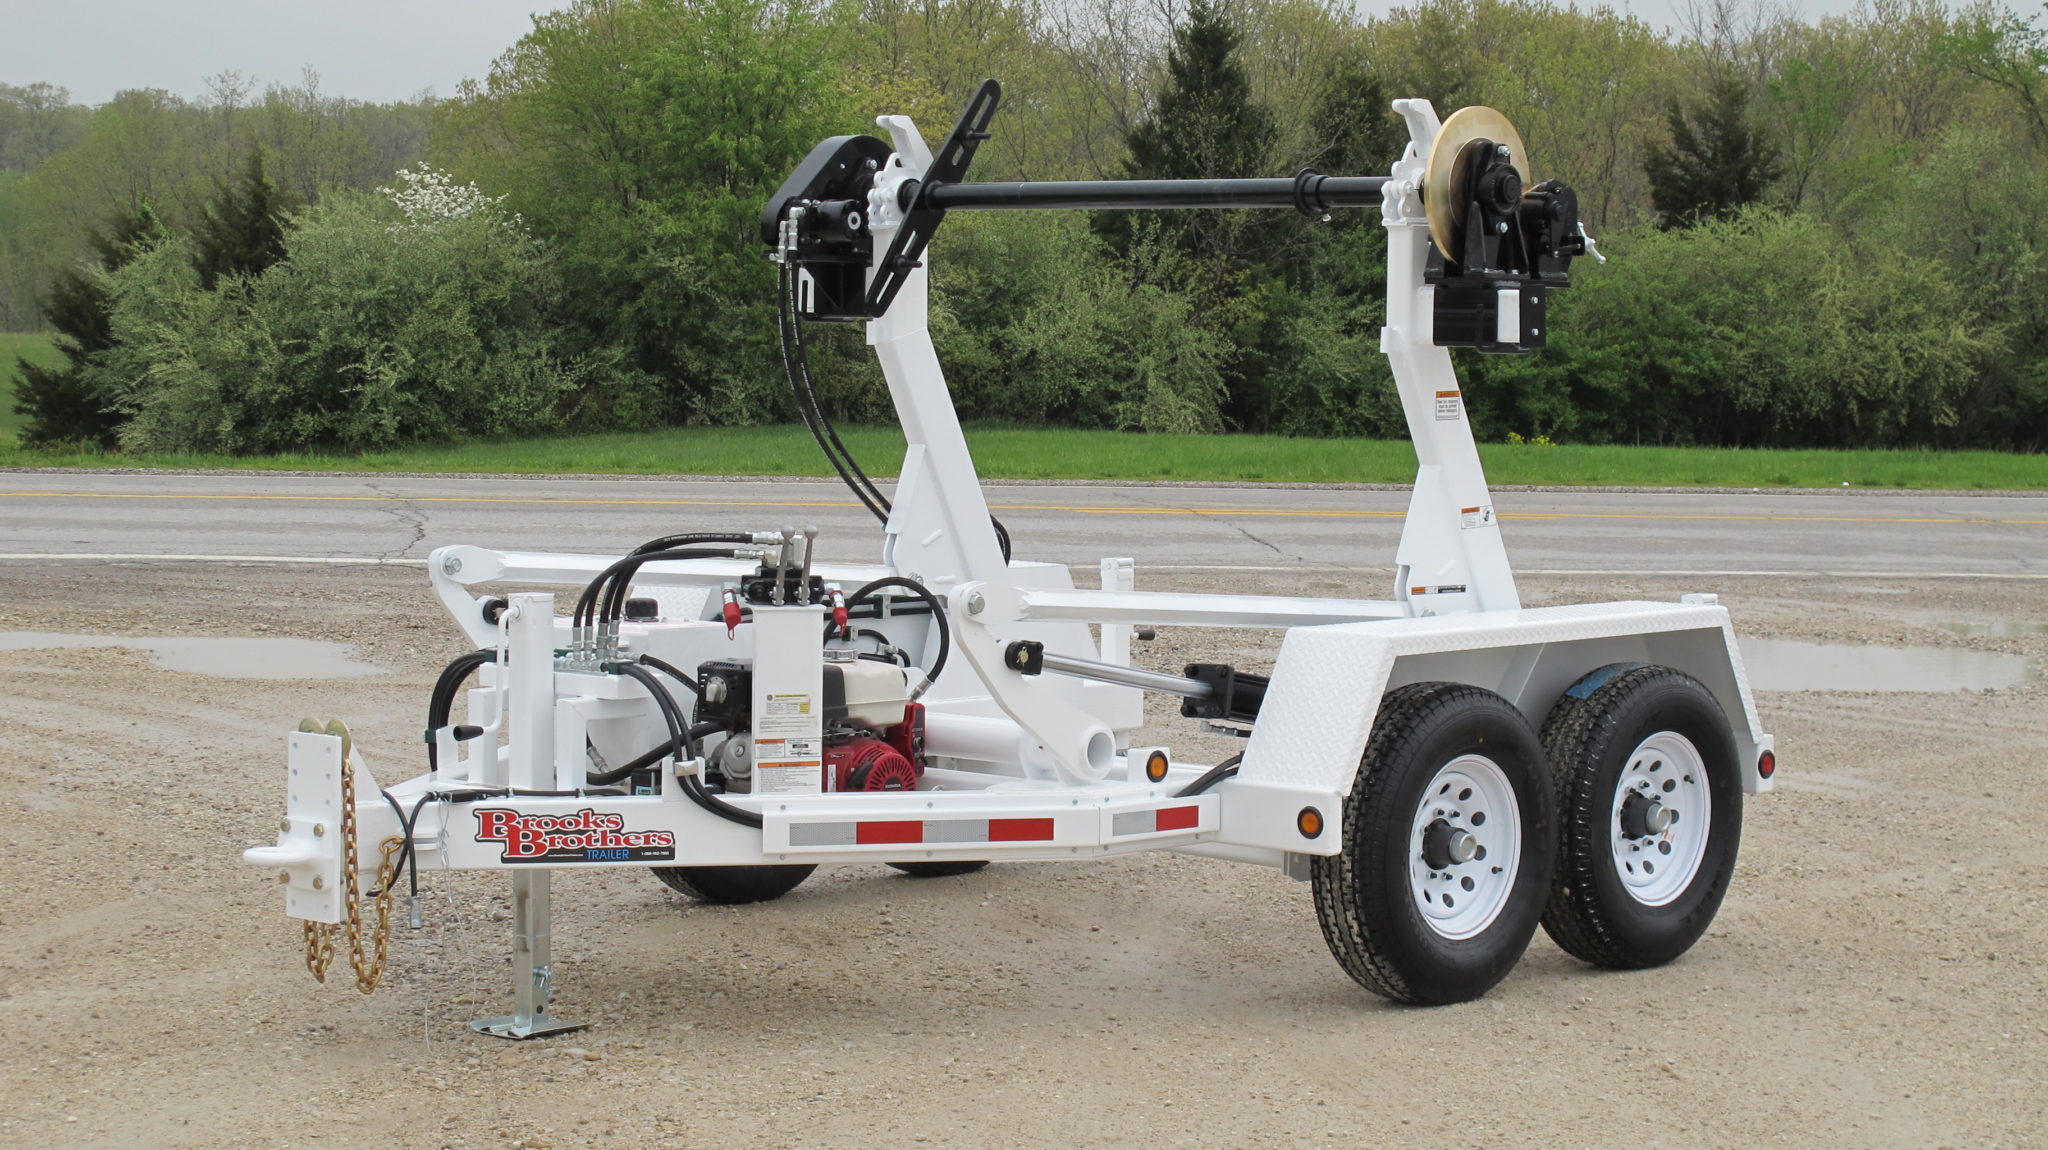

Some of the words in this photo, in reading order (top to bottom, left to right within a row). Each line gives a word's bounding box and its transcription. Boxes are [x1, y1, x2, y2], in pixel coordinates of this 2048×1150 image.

[475, 809, 623, 840] Brooks
[504, 828, 674, 858] Brothers
[587, 849, 629, 860] TRAILER
